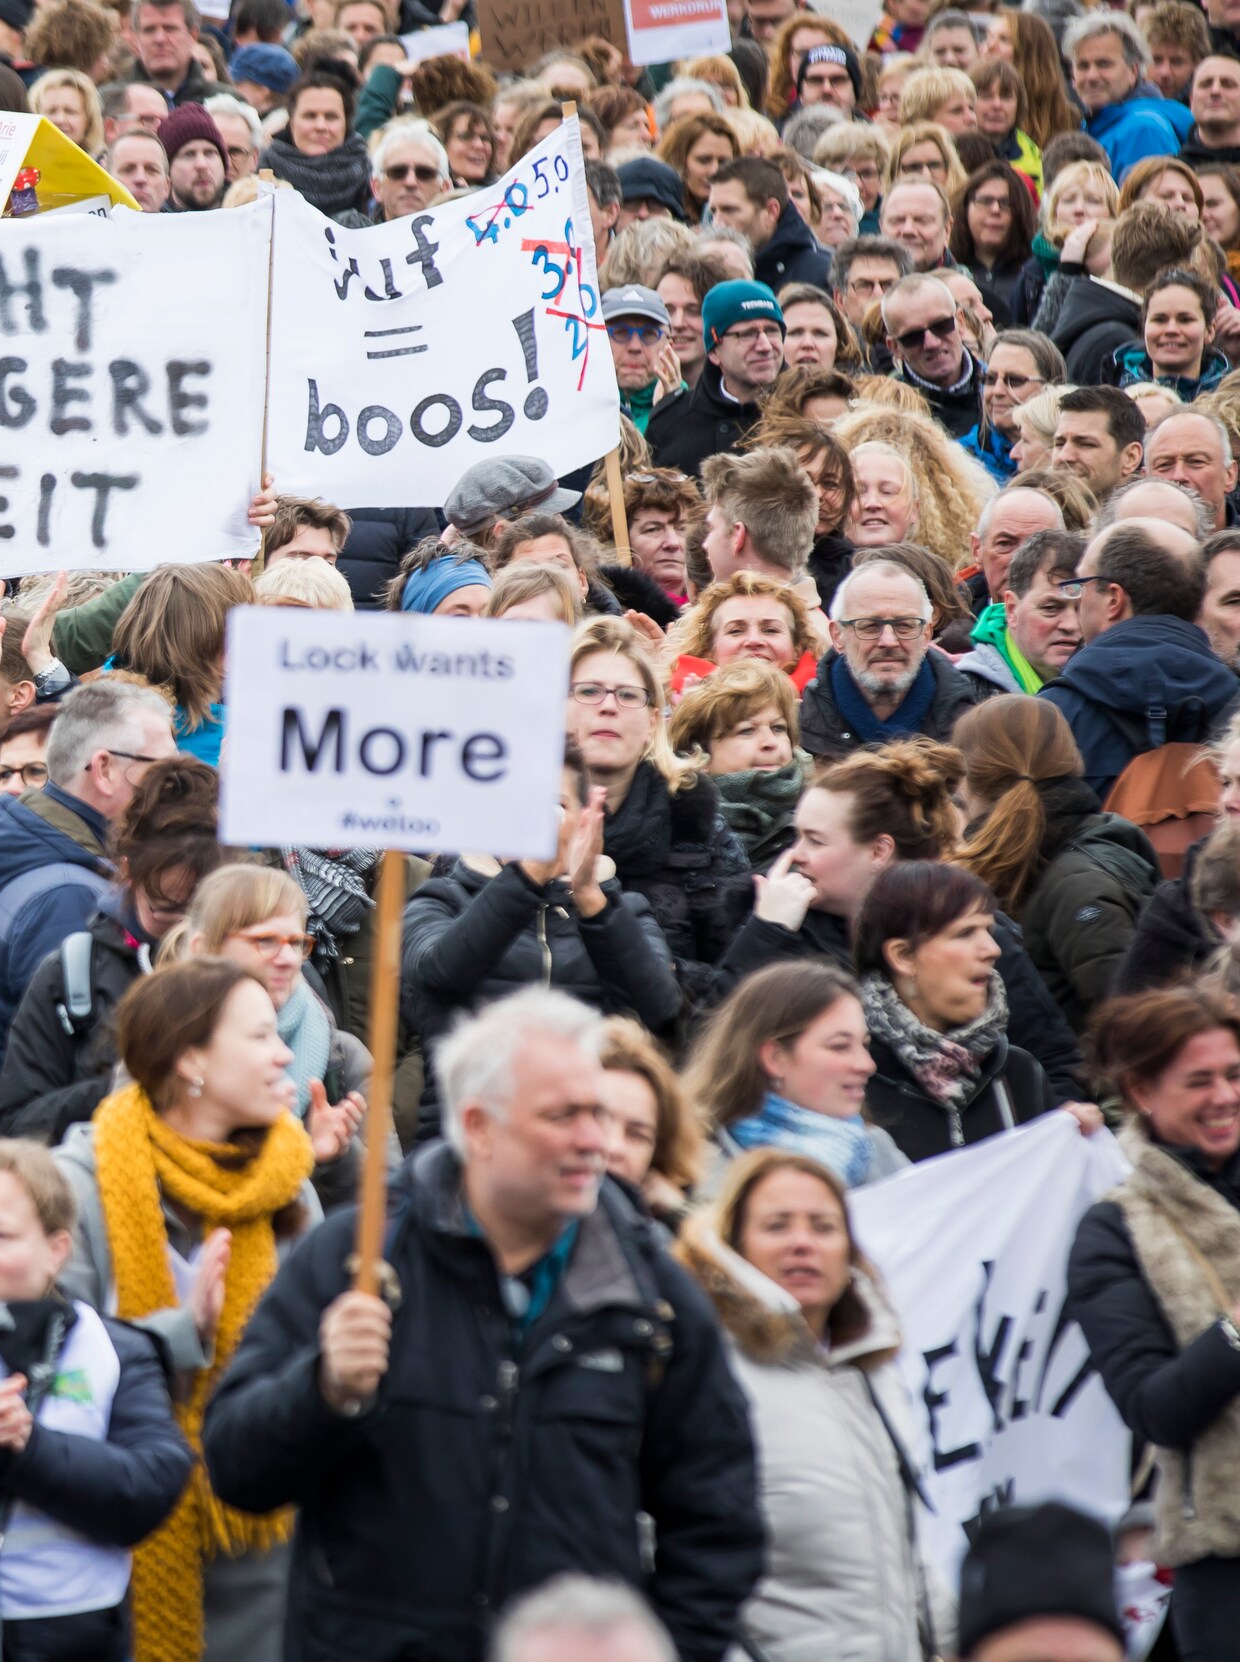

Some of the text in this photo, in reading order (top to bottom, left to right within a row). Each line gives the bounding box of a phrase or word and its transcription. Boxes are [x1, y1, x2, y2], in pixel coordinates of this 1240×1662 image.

[532, 155, 569, 199] 5.0
[304, 306, 549, 456] boos!
[279, 641, 379, 672] Lock
[279, 707, 510, 783] More
